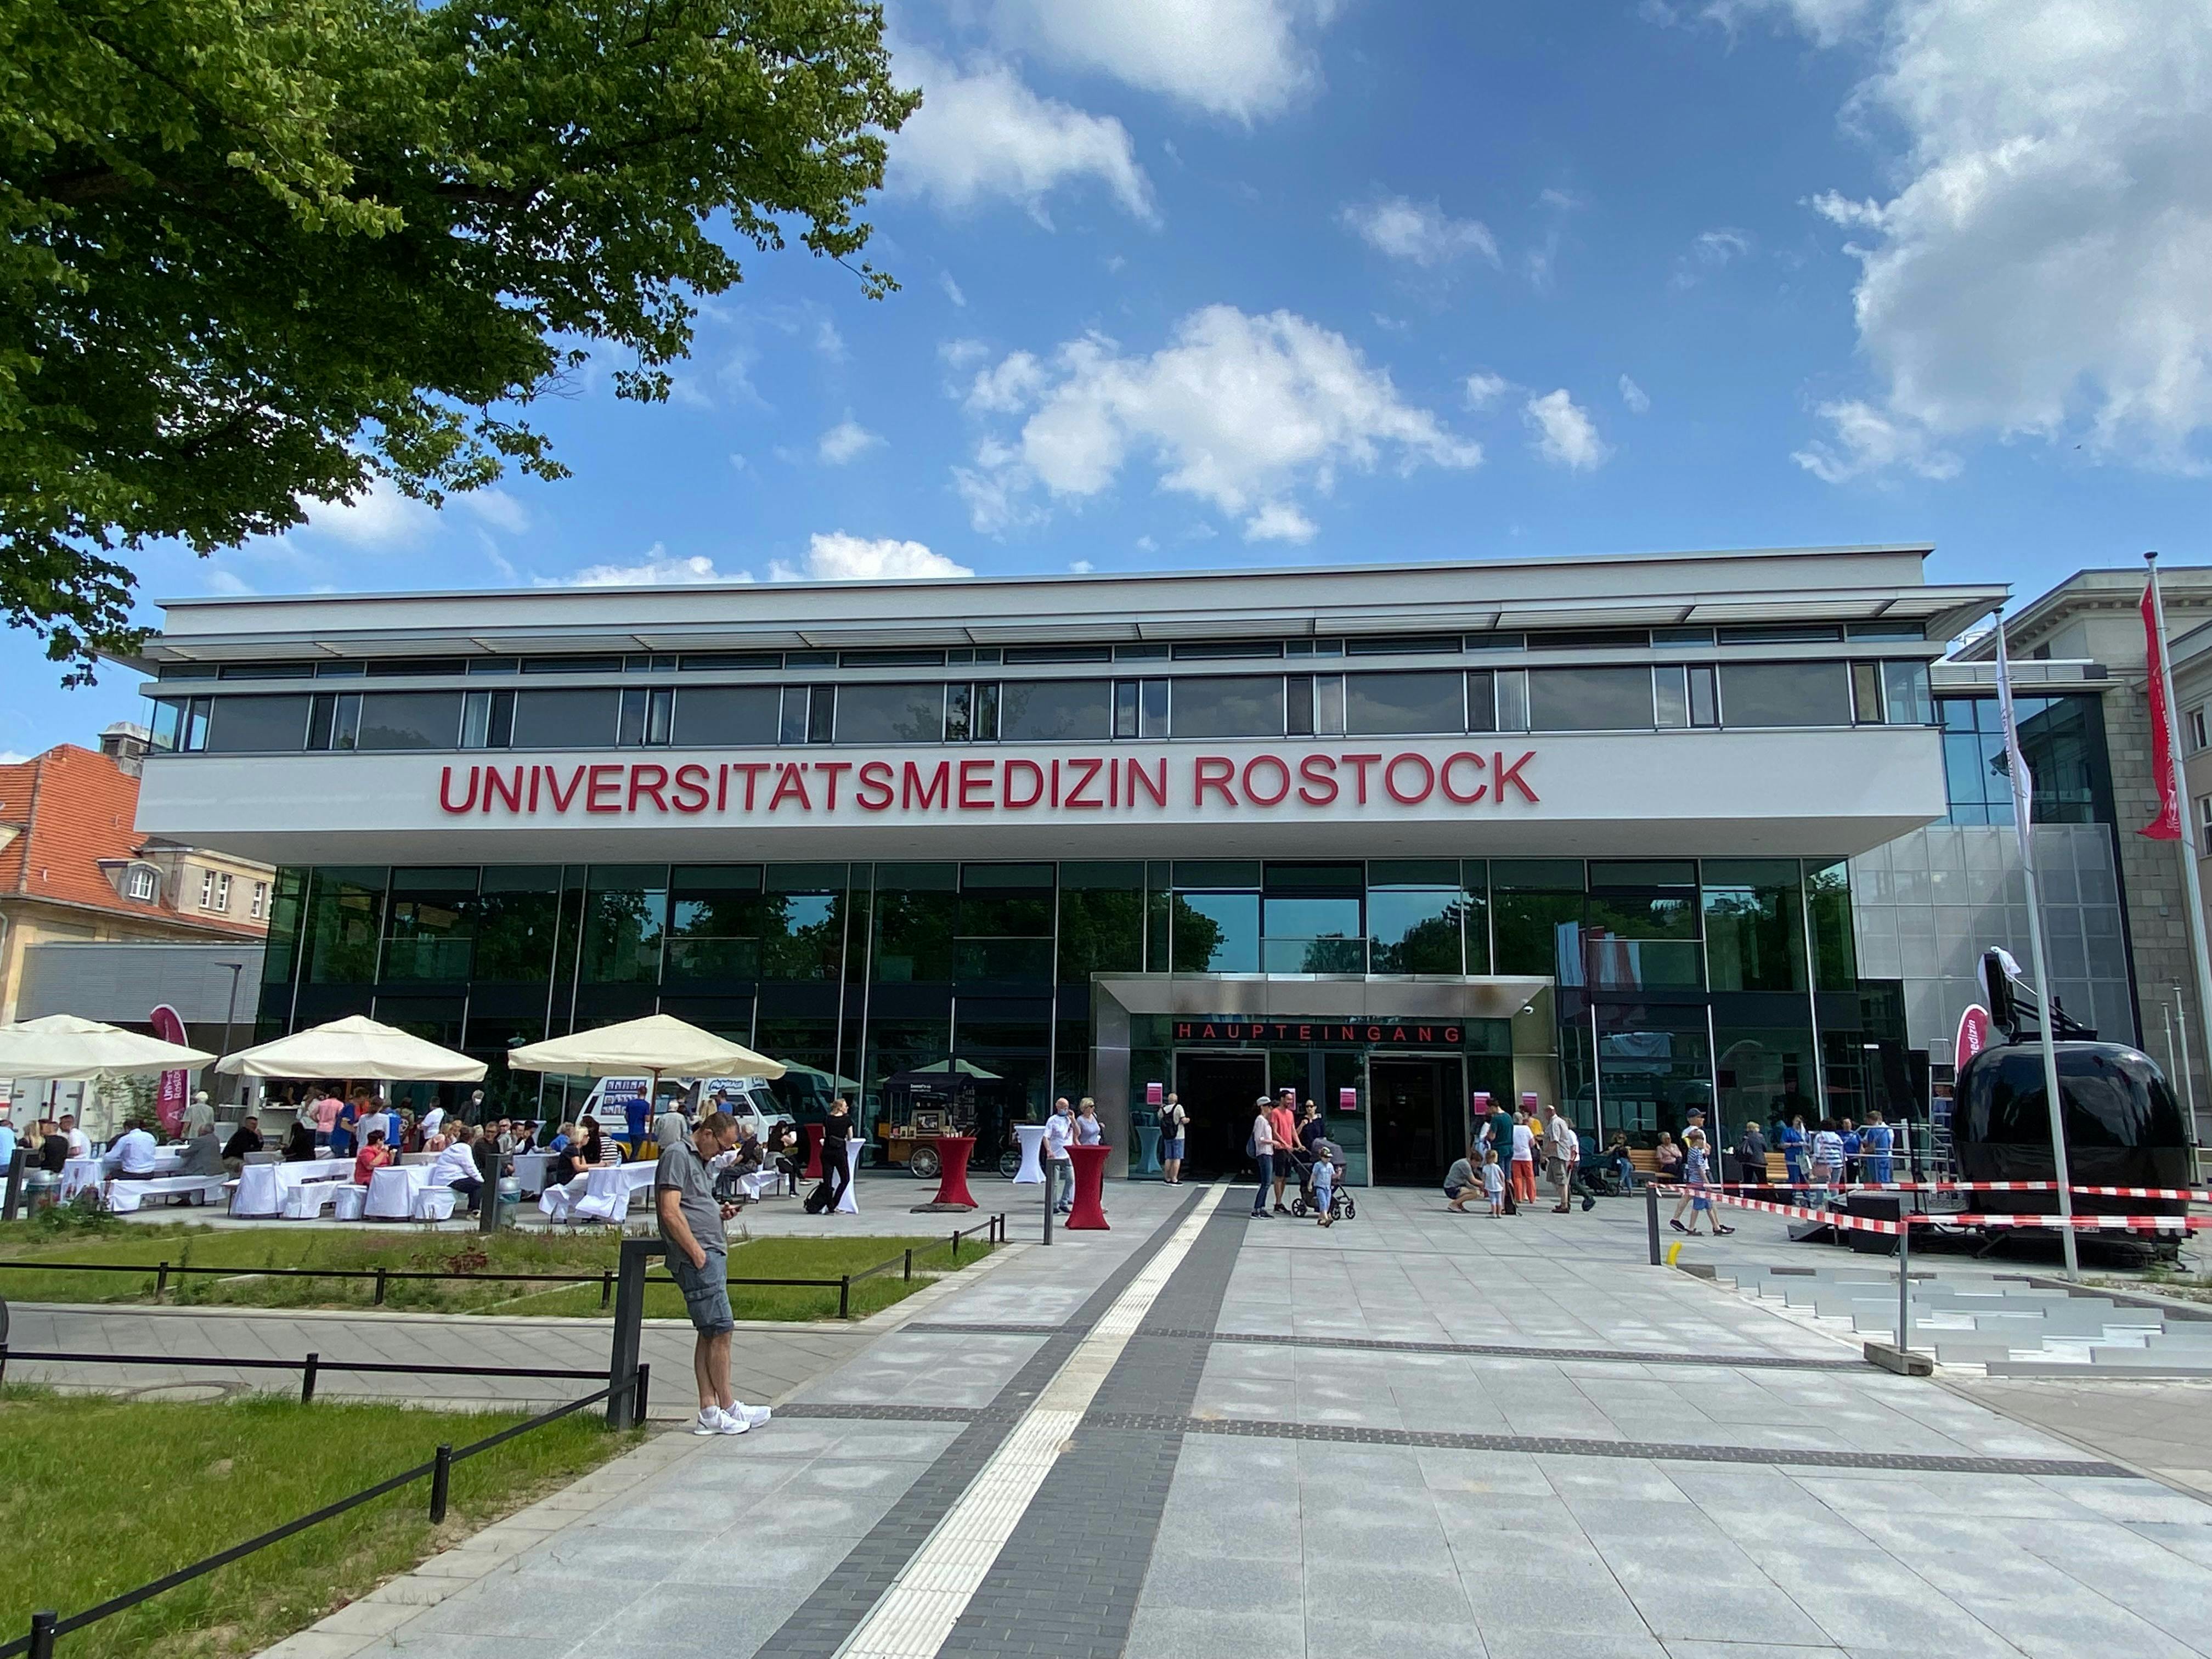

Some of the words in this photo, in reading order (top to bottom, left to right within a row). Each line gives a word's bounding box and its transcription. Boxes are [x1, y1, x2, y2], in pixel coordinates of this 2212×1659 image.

[440, 758, 1166, 814] UNIVERSITÄTSMEDIZIN
[1195, 752, 1537, 805] ROSTOCK
[1178, 1023, 1459, 1042] HAUPTEINGANG
